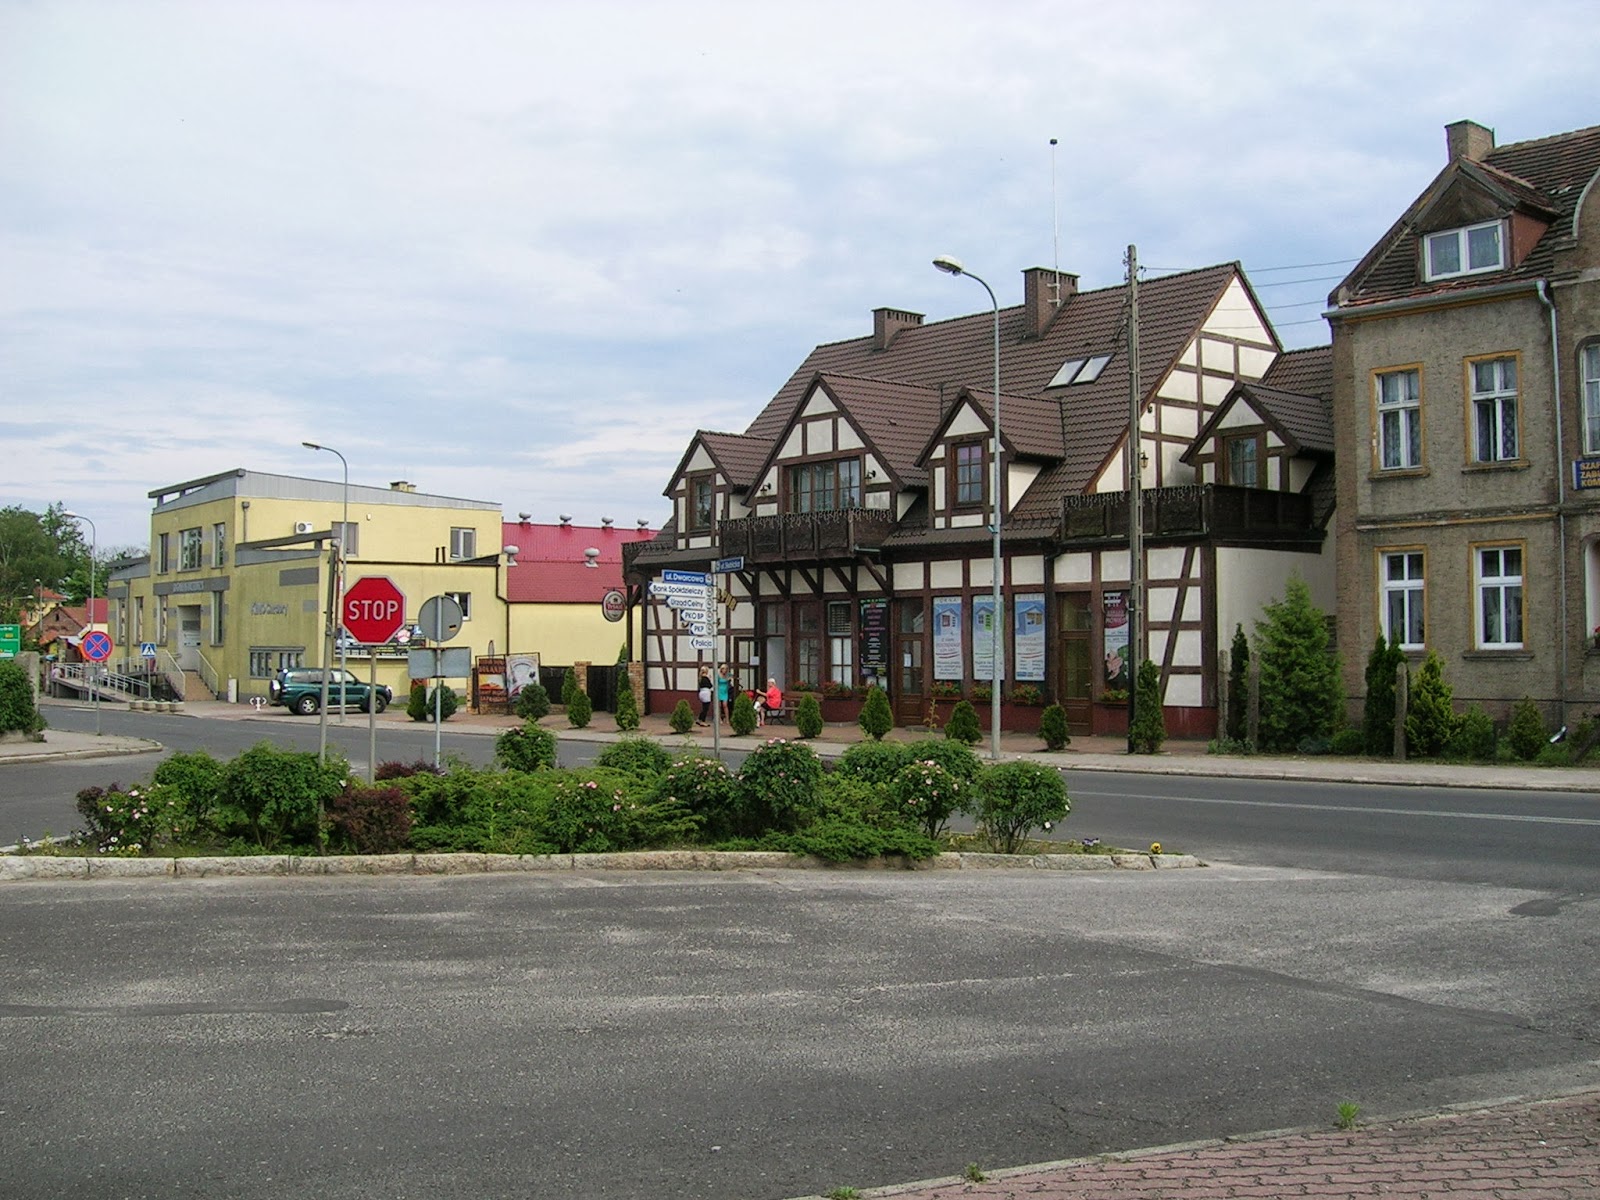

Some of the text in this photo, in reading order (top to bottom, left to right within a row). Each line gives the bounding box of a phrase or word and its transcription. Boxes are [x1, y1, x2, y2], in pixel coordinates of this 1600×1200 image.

[653, 584, 668, 592] Bank
[348, 600, 399, 621] STOP
[684, 611, 696, 619] PKO
